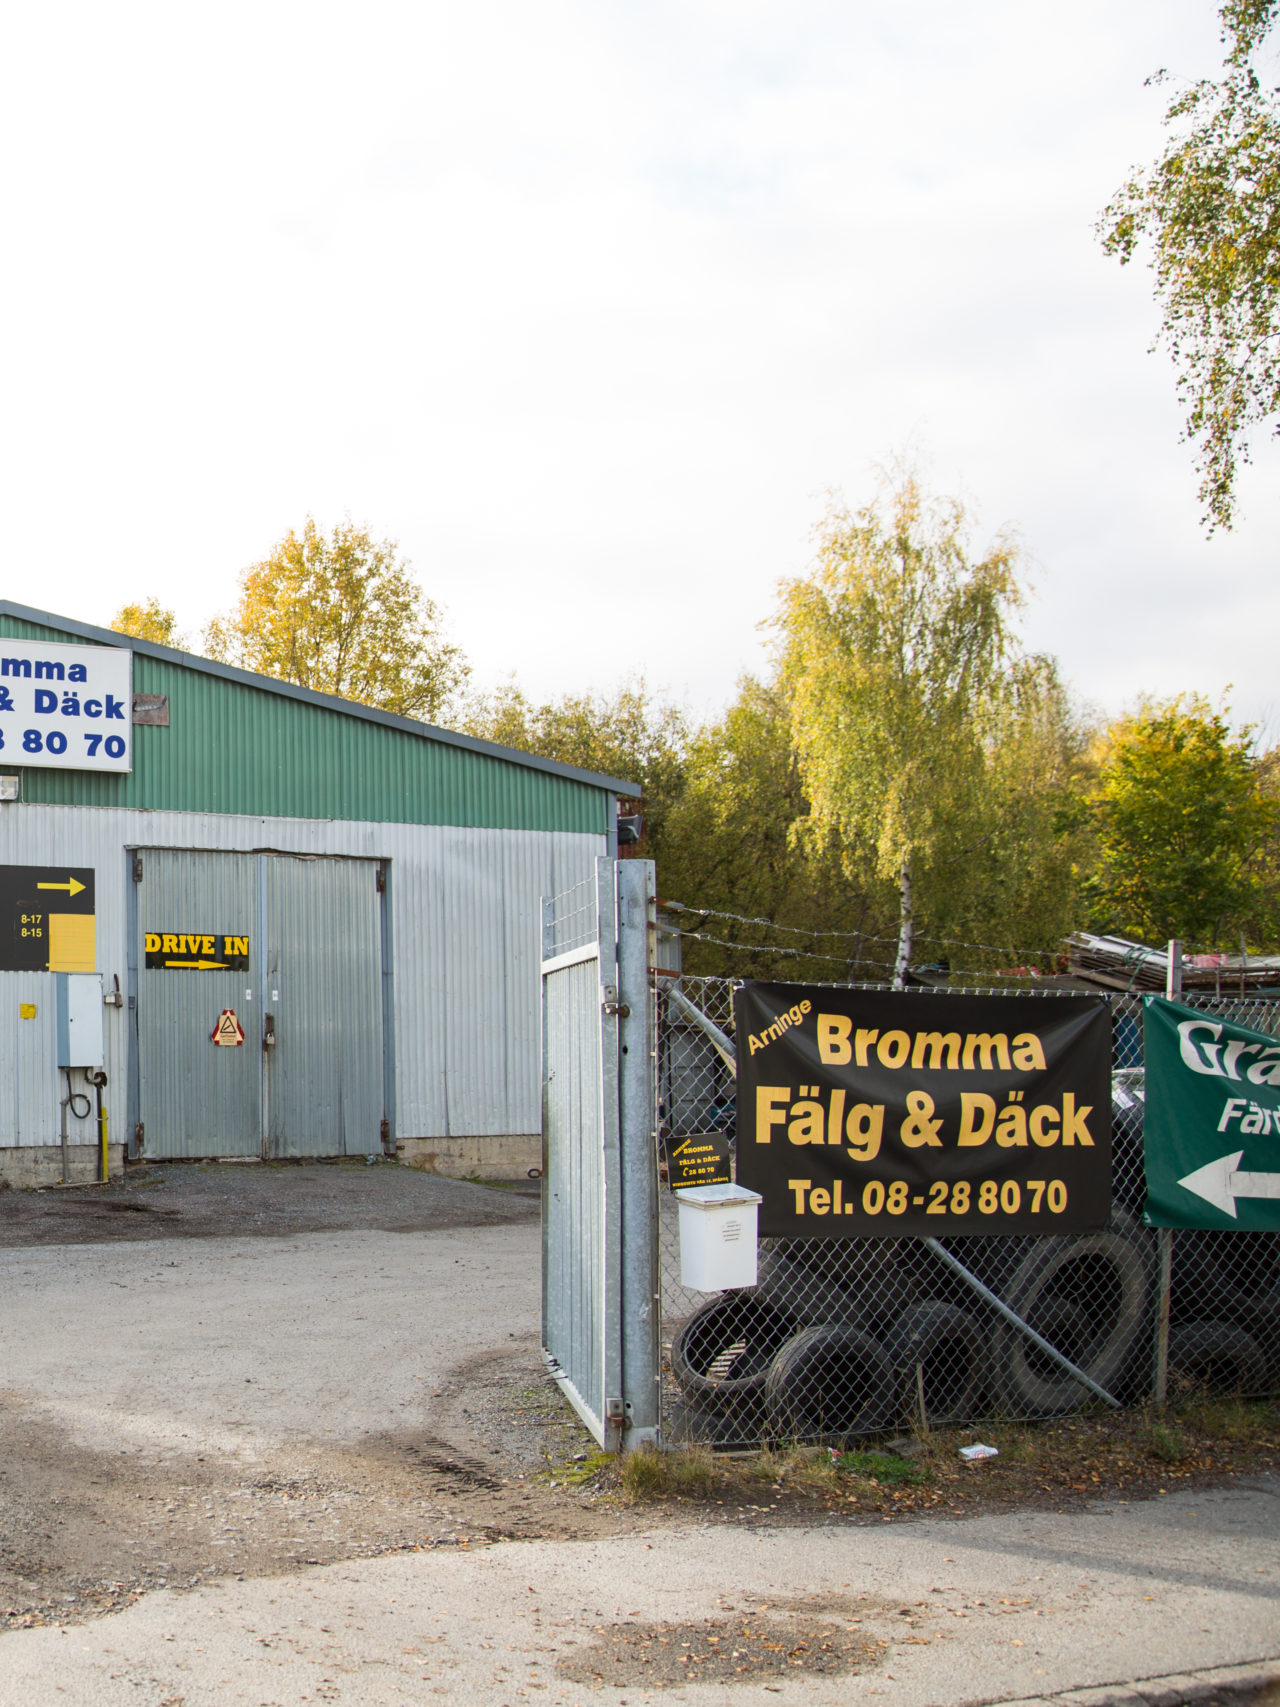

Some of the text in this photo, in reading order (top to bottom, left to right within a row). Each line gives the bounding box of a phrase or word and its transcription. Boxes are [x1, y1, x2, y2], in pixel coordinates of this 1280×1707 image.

[34, 689, 125, 720] Däck
[22, 729, 68, 755] 80
[84, 733, 126, 759] 70
[21, 914, 42, 924] 8-17
[21, 928, 42, 937] 8-15
[145, 933, 249, 956] DRIVE IN
[747, 999, 812, 1056] Arninge
[817, 1013, 1047, 1071] Bromma
[756, 1085, 1096, 1161] Fälg & Däck
[788, 1179, 854, 1215] Tel.
[978, 1179, 1021, 1214] 80
[1027, 1179, 1068, 1214] 70
